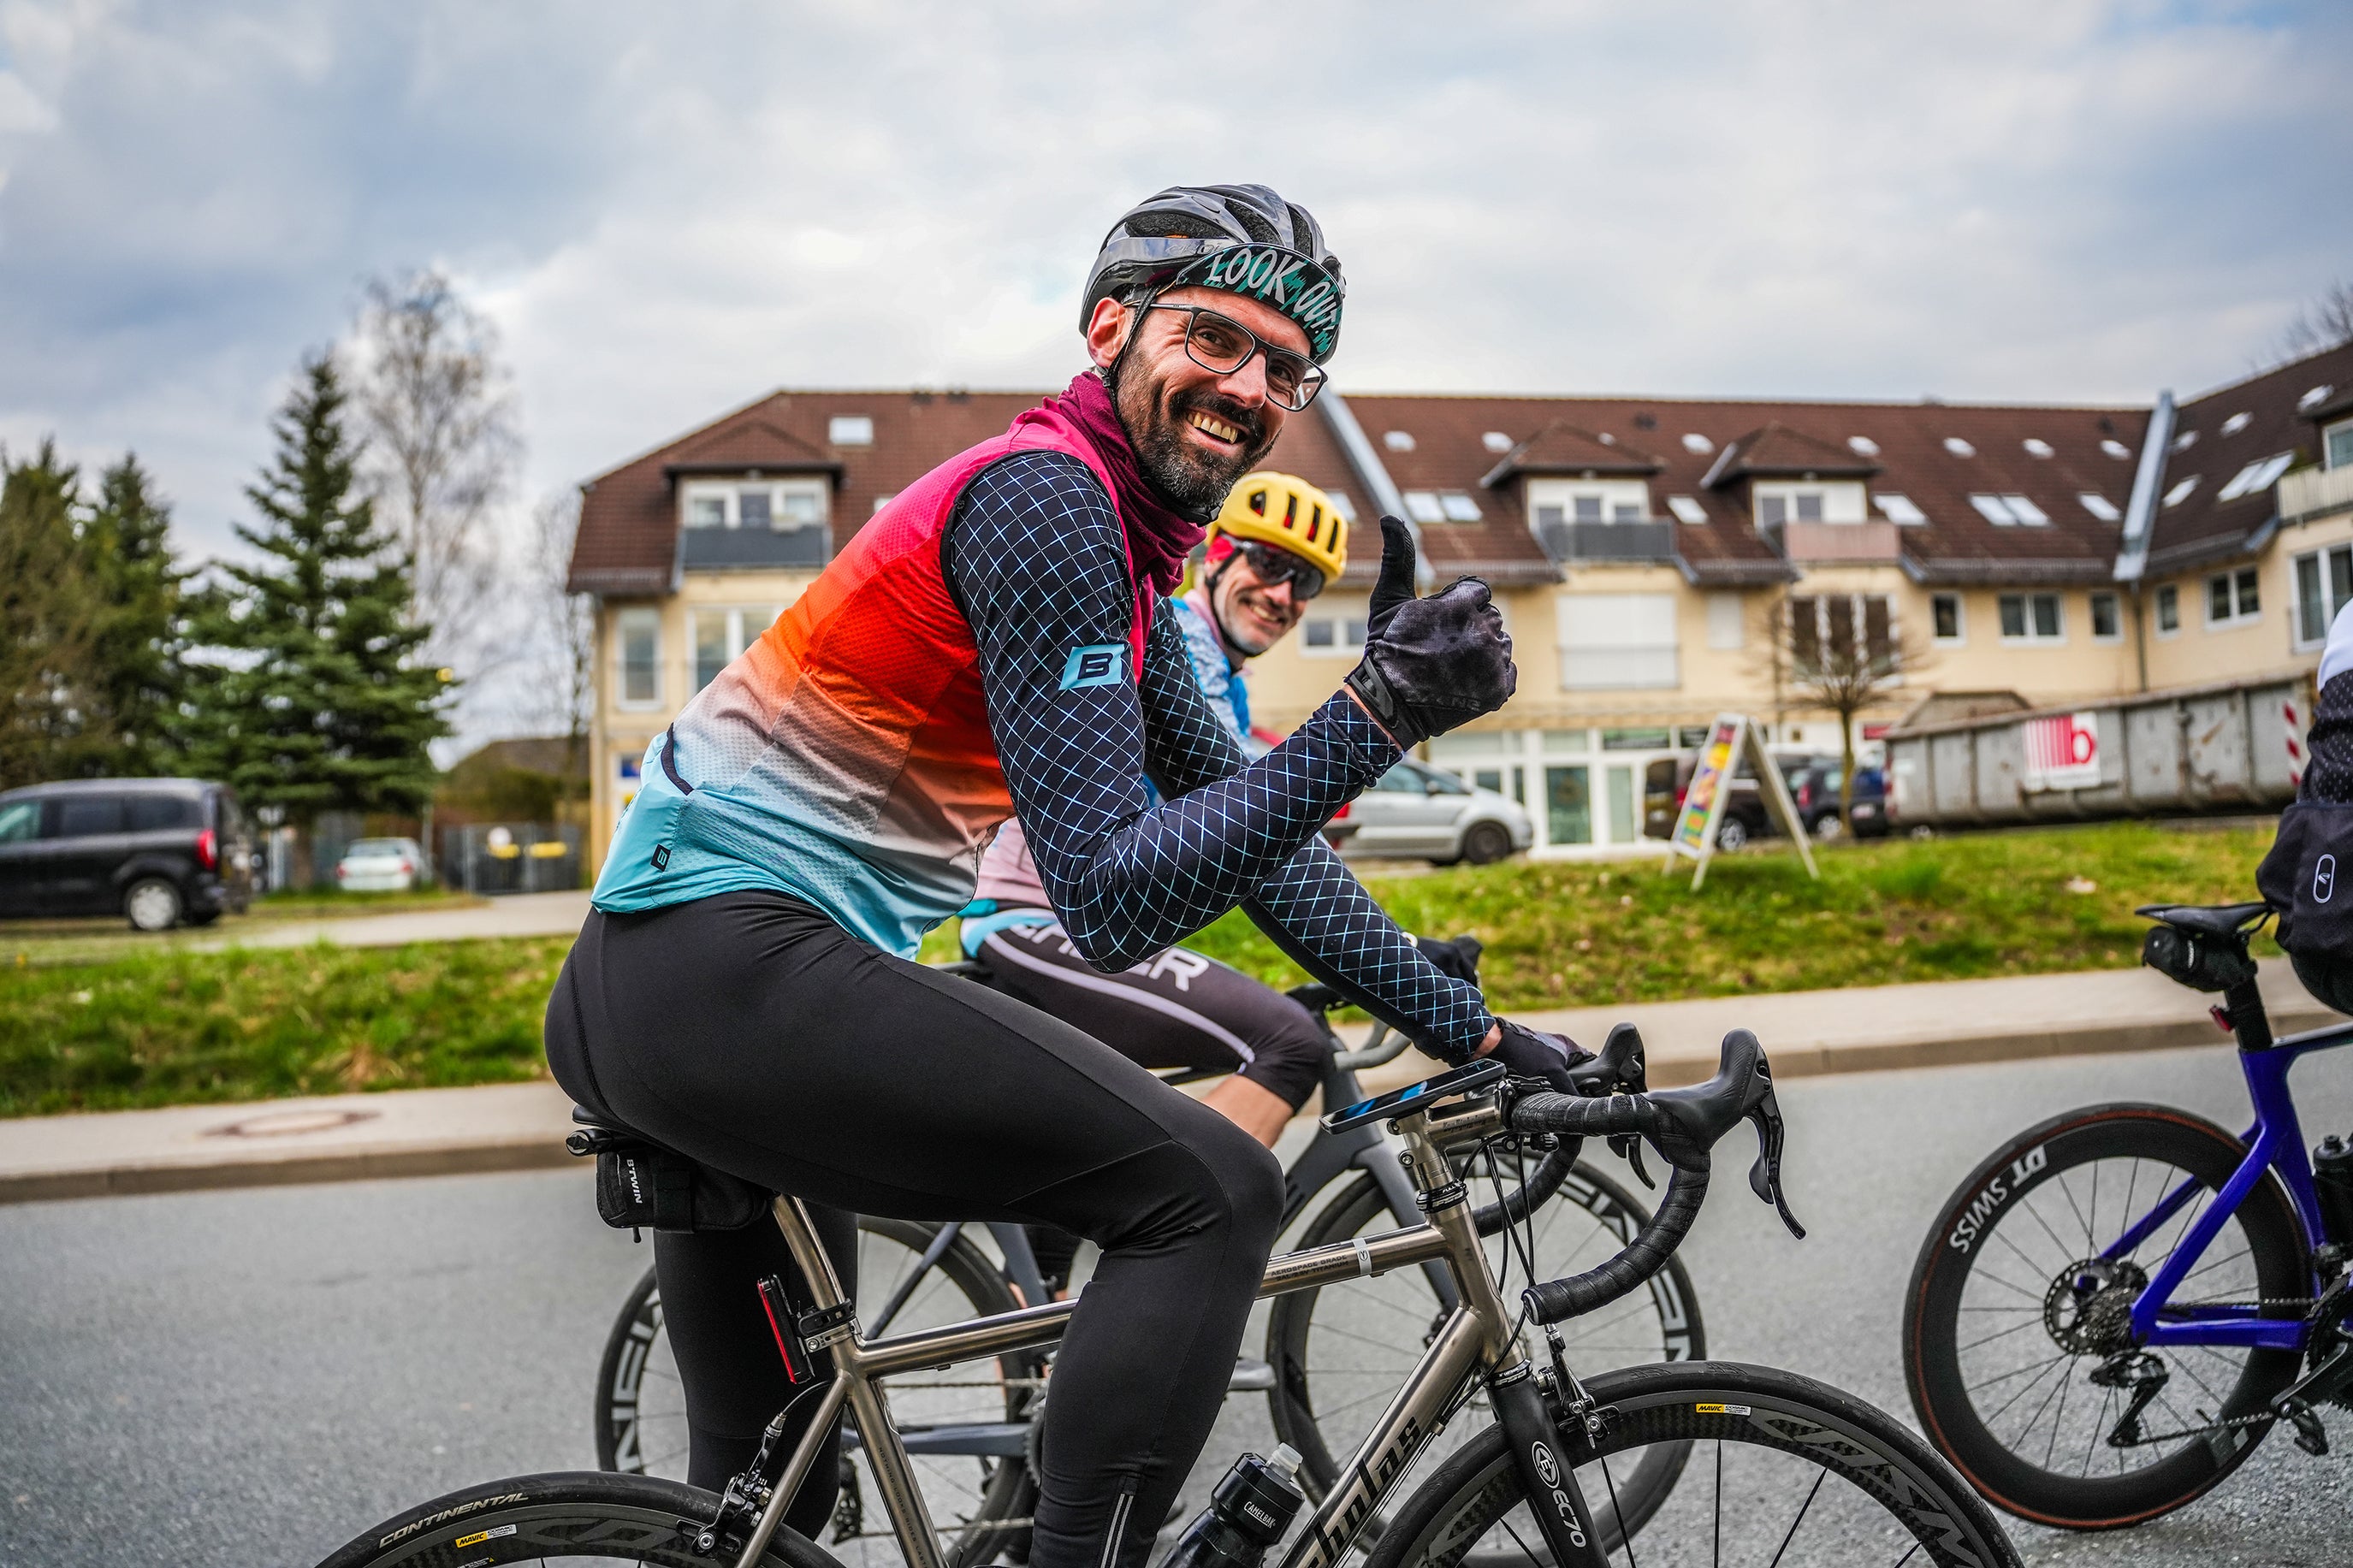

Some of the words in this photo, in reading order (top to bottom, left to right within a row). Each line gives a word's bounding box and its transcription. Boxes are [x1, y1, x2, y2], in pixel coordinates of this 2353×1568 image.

[1207, 247, 1307, 305] LOOK
[2012, 1145, 2048, 1188] DT
[1949, 1177, 2007, 1254] SWISS
[379, 1493, 529, 1548] CONTINENTAL
[1243, 1501, 1276, 1529] CAMELBAK
[1307, 1417, 1421, 1568] holas
[1552, 1489, 1586, 1547] EC70
[459, 1533, 484, 1546] MAVIC
